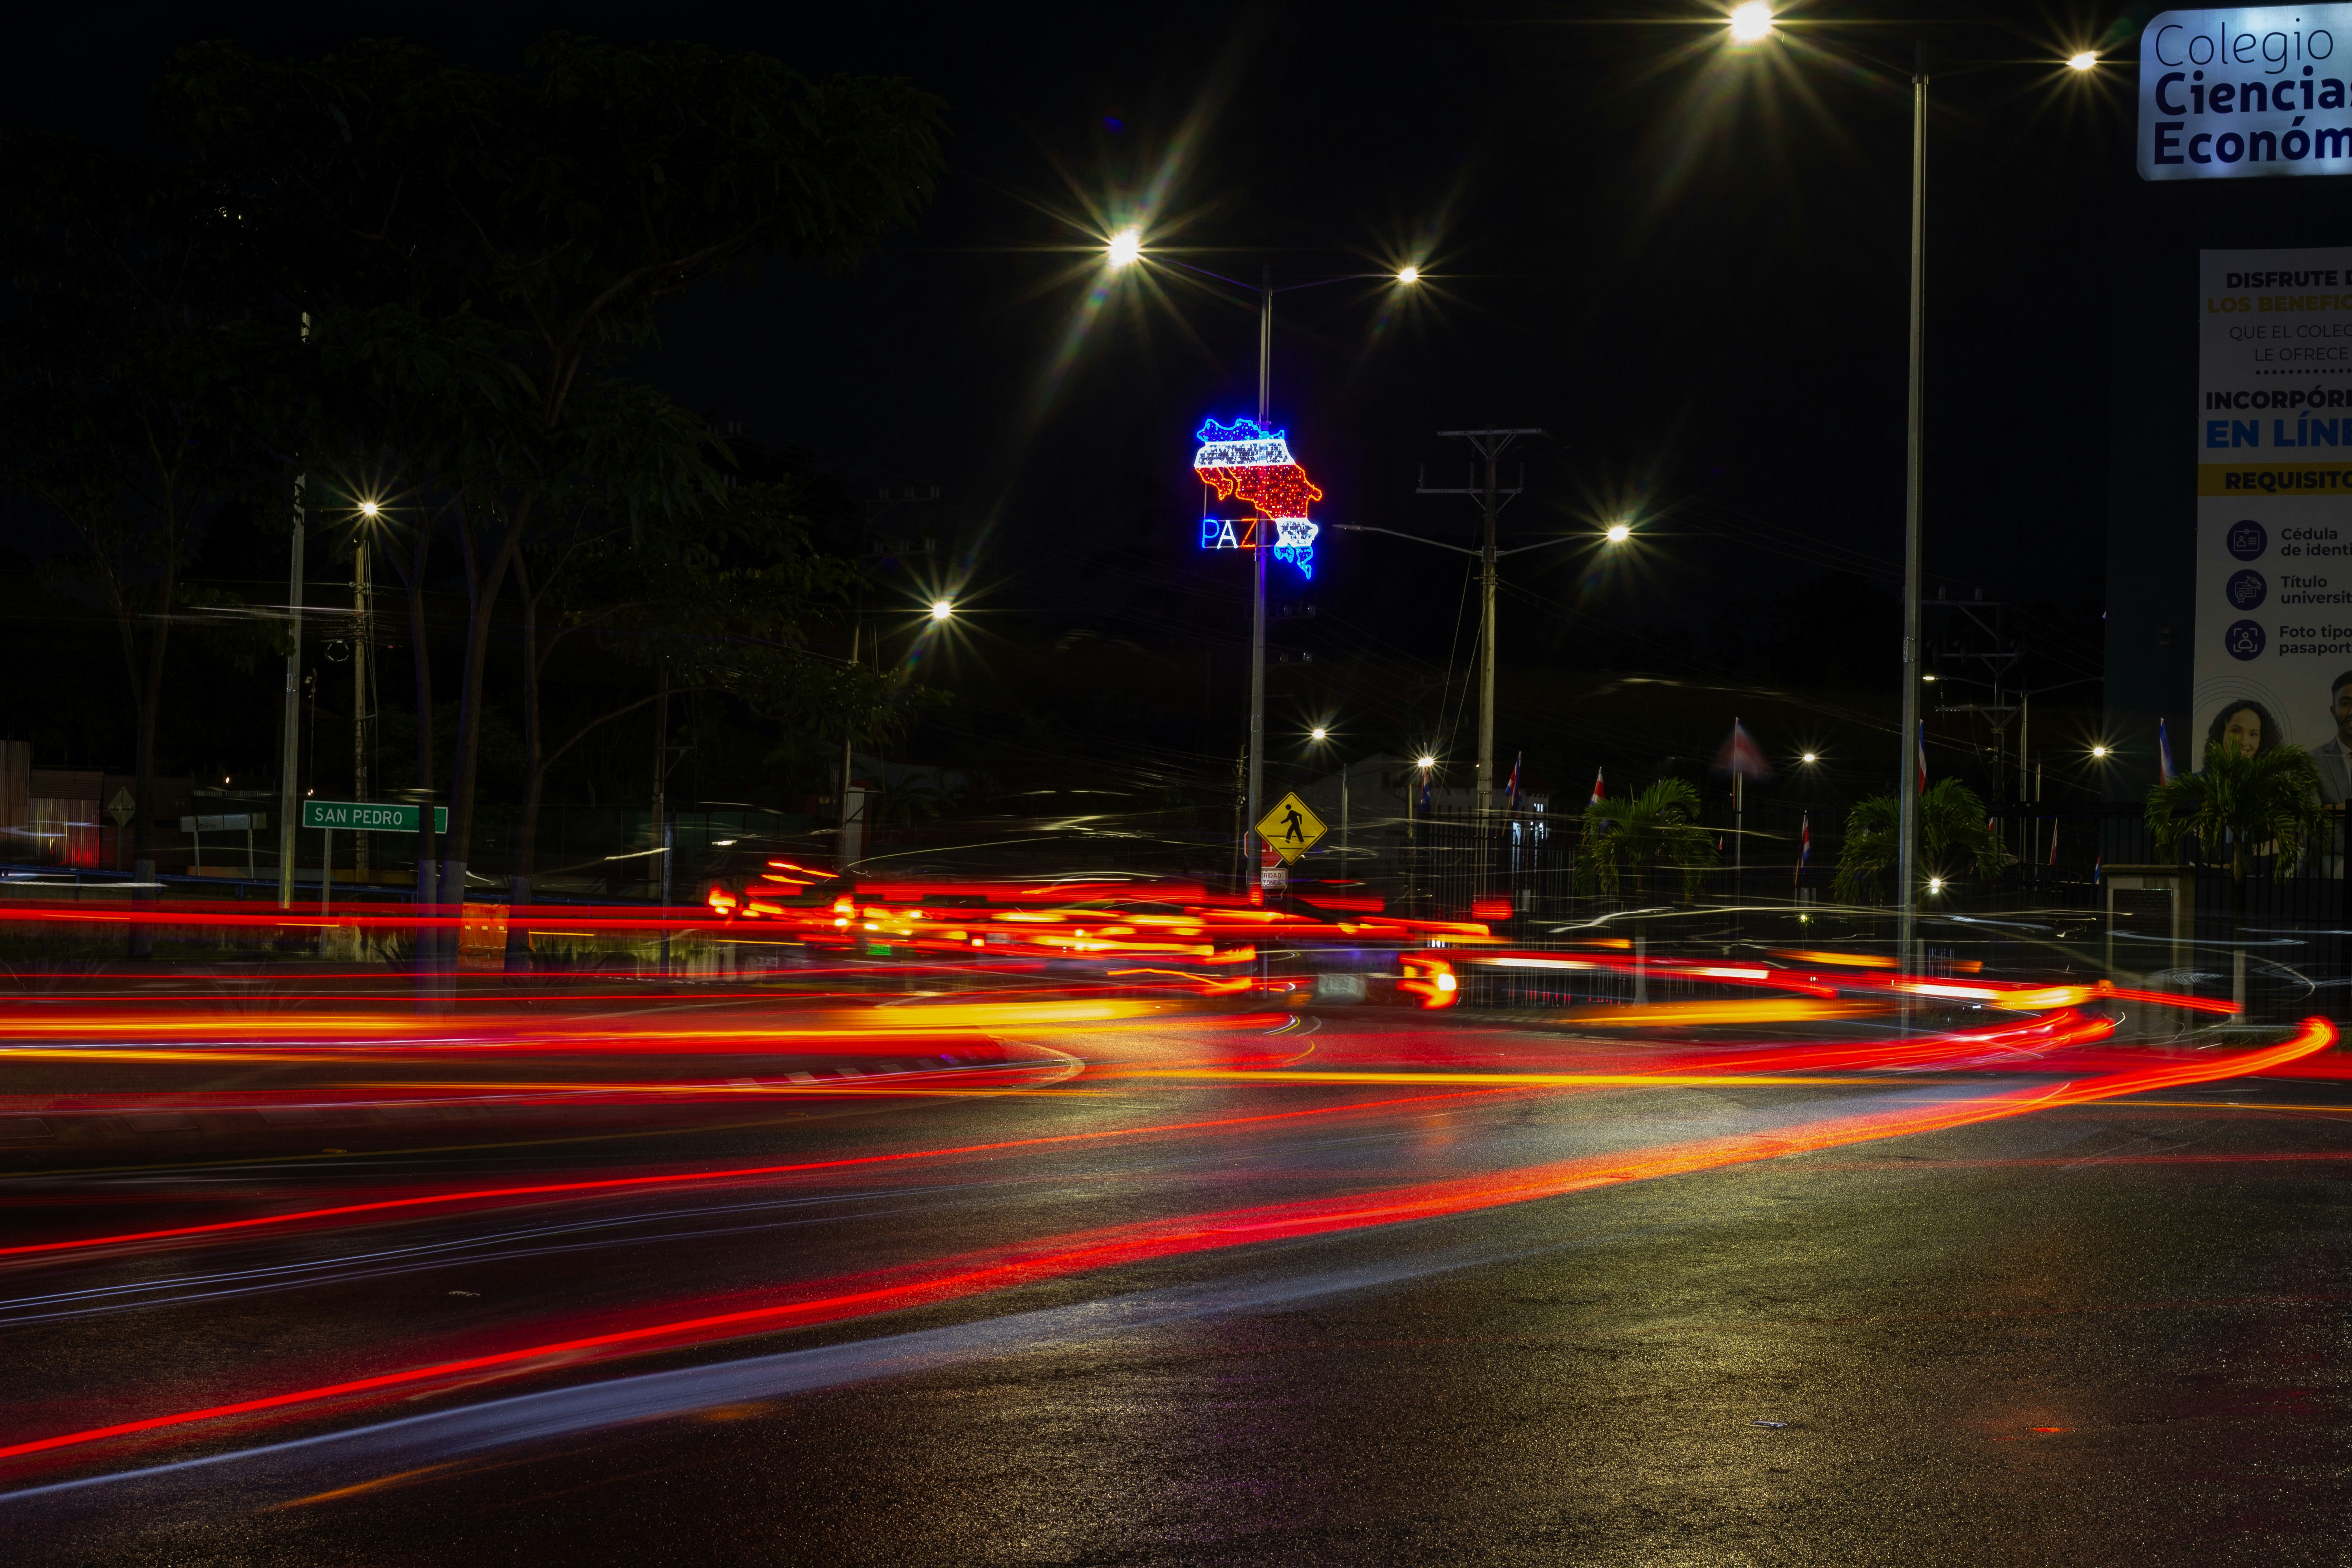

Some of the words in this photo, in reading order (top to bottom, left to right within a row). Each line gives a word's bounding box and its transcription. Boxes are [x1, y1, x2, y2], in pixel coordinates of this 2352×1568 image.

[2155, 18, 2333, 74] Colegio
[2155, 65, 2352, 116] Ciencia
[2154, 116, 2352, 165] Económ
[2227, 270, 2338, 288] DISFRUTE
[2208, 297, 2251, 313] LOS
[2230, 326, 2266, 341] QUE
[2273, 325, 2292, 338] EL
[2255, 348, 2274, 361] LE
[2279, 347, 2348, 360] OFRECE
[2206, 420, 2259, 448] EN
[1202, 518, 1259, 549] PAZ
[2281, 528, 2338, 540] Cédula
[2281, 544, 2301, 556] de
[2307, 543, 2352, 556] identi
[2281, 576, 2328, 588] Título
[2281, 591, 2352, 604] universit
[2279, 626, 2316, 637] Foto
[2321, 625, 2352, 640] tipo
[2279, 642, 2352, 657] pasaport
[314, 807, 347, 823] SAN
[353, 809, 403, 825] PEDRO
